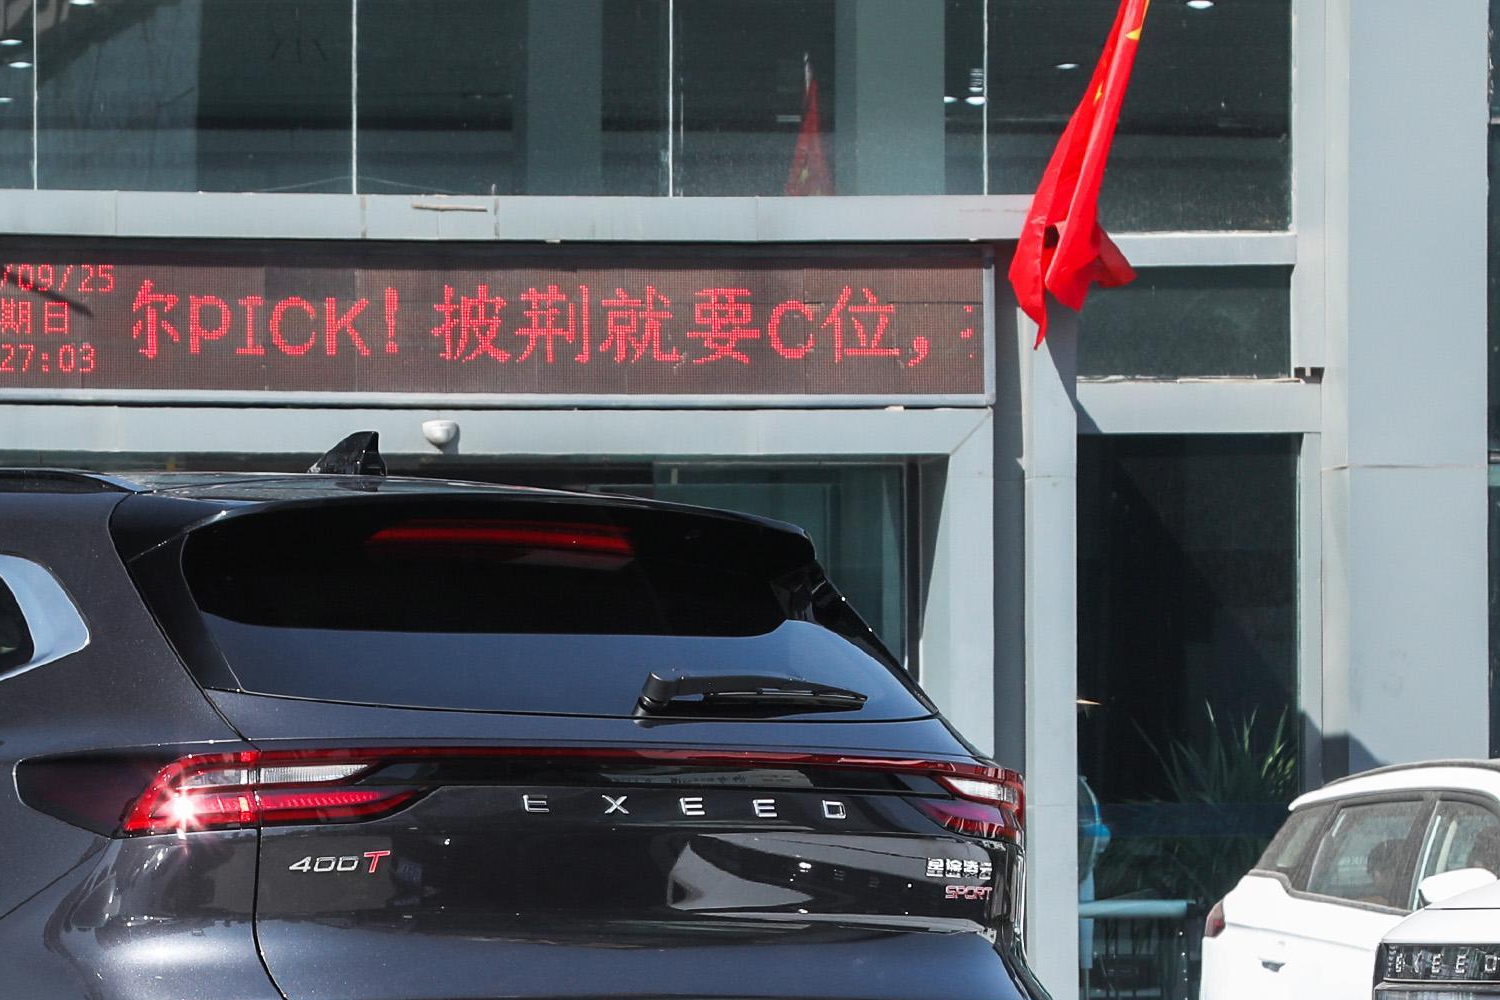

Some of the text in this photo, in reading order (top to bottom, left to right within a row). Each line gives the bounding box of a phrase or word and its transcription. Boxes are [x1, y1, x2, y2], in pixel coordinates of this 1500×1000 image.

[522, 794, 847, 820] EXEED
[288, 850, 391, 874] 400T
[945, 885, 993, 900] SPORT
